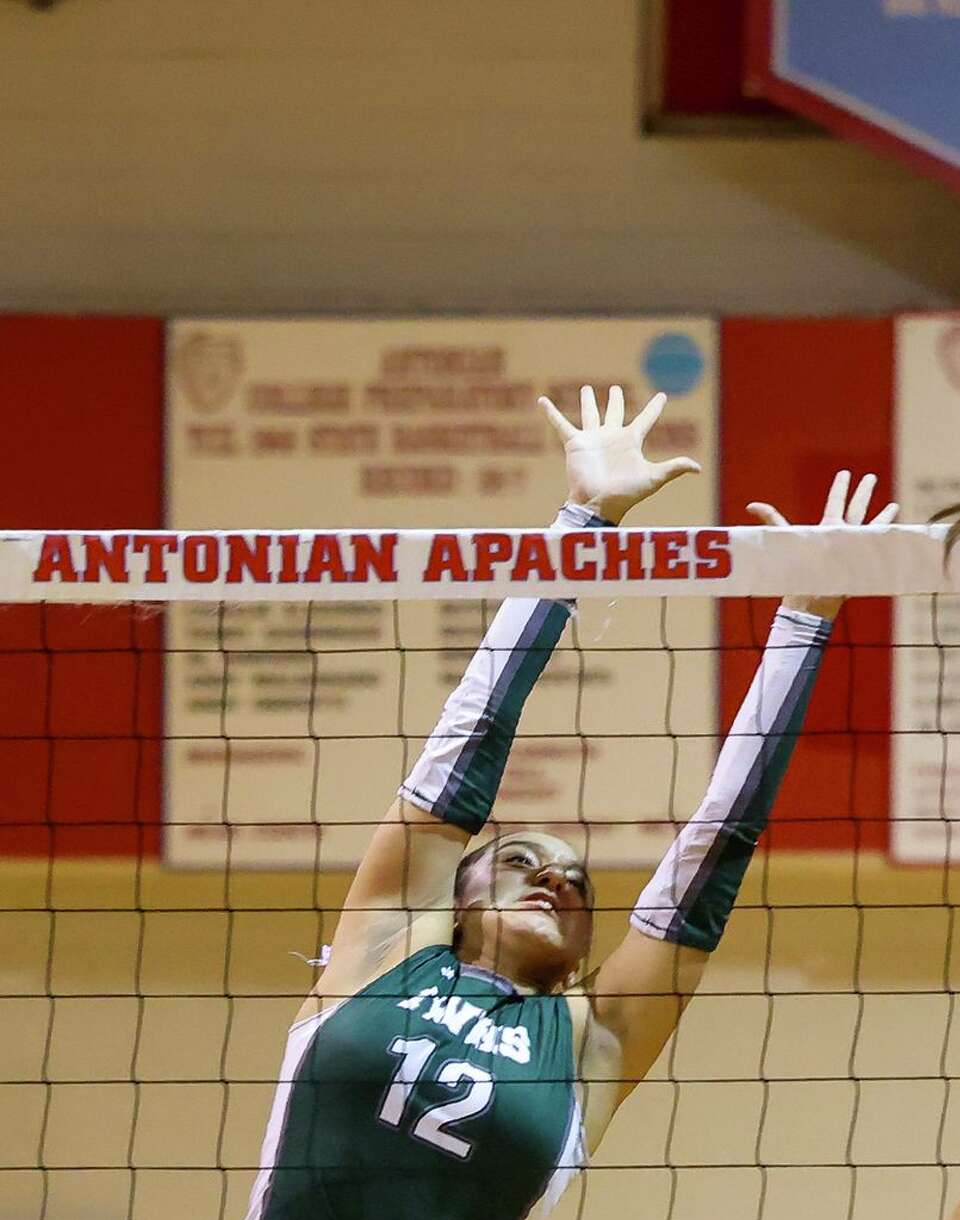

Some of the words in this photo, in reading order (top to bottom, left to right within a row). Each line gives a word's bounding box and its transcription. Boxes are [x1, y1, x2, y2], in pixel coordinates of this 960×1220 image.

[33, 534, 398, 584] ANTONIAN
[423, 531, 733, 582] APACHES
[378, 1036, 496, 1161] 12
